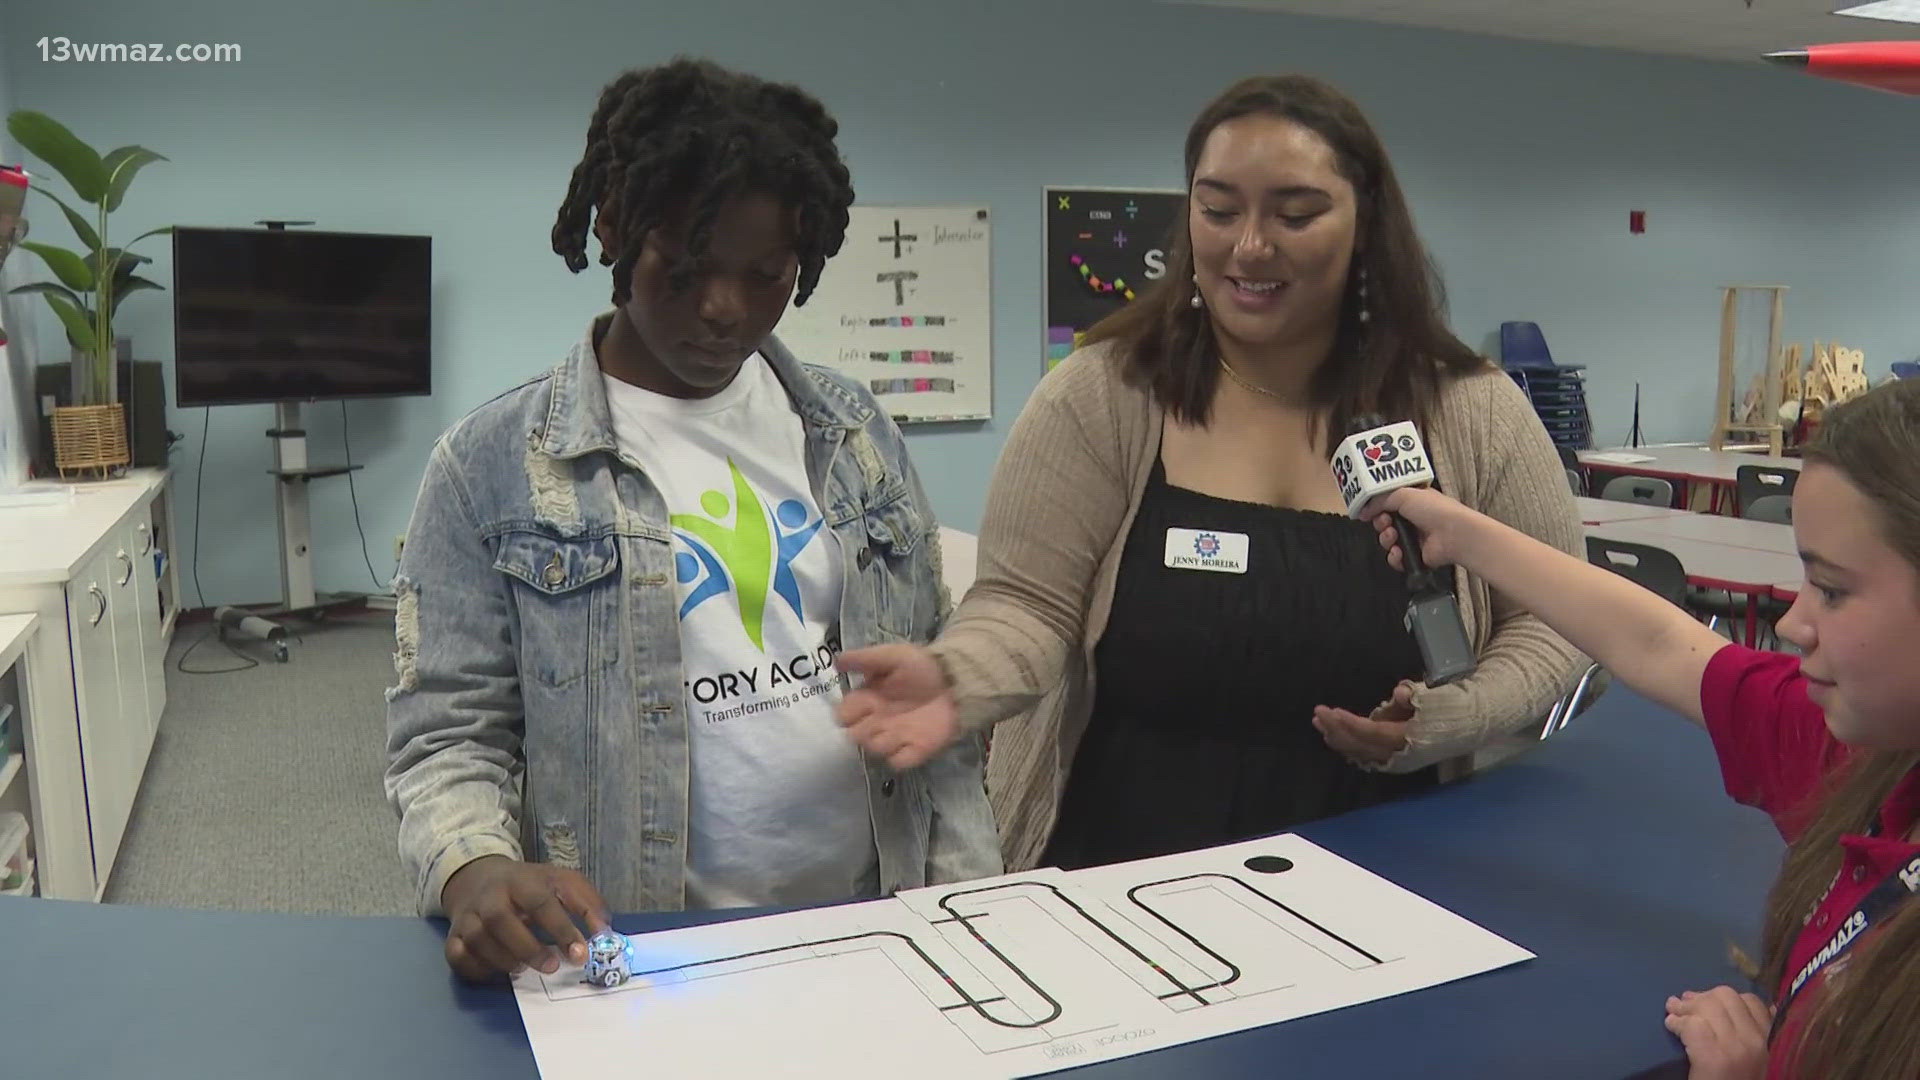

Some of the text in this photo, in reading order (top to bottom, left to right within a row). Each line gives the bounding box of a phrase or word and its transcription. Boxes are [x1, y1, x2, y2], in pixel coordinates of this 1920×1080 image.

[1355, 433, 1399, 468] 13
[1368, 456, 1426, 484] WMAZ
[1172, 556, 1239, 568] JENNY MOREIRA
[684, 667, 758, 704] ORY
[702, 696, 791, 724] Transforming
[792, 693, 799, 703] a
